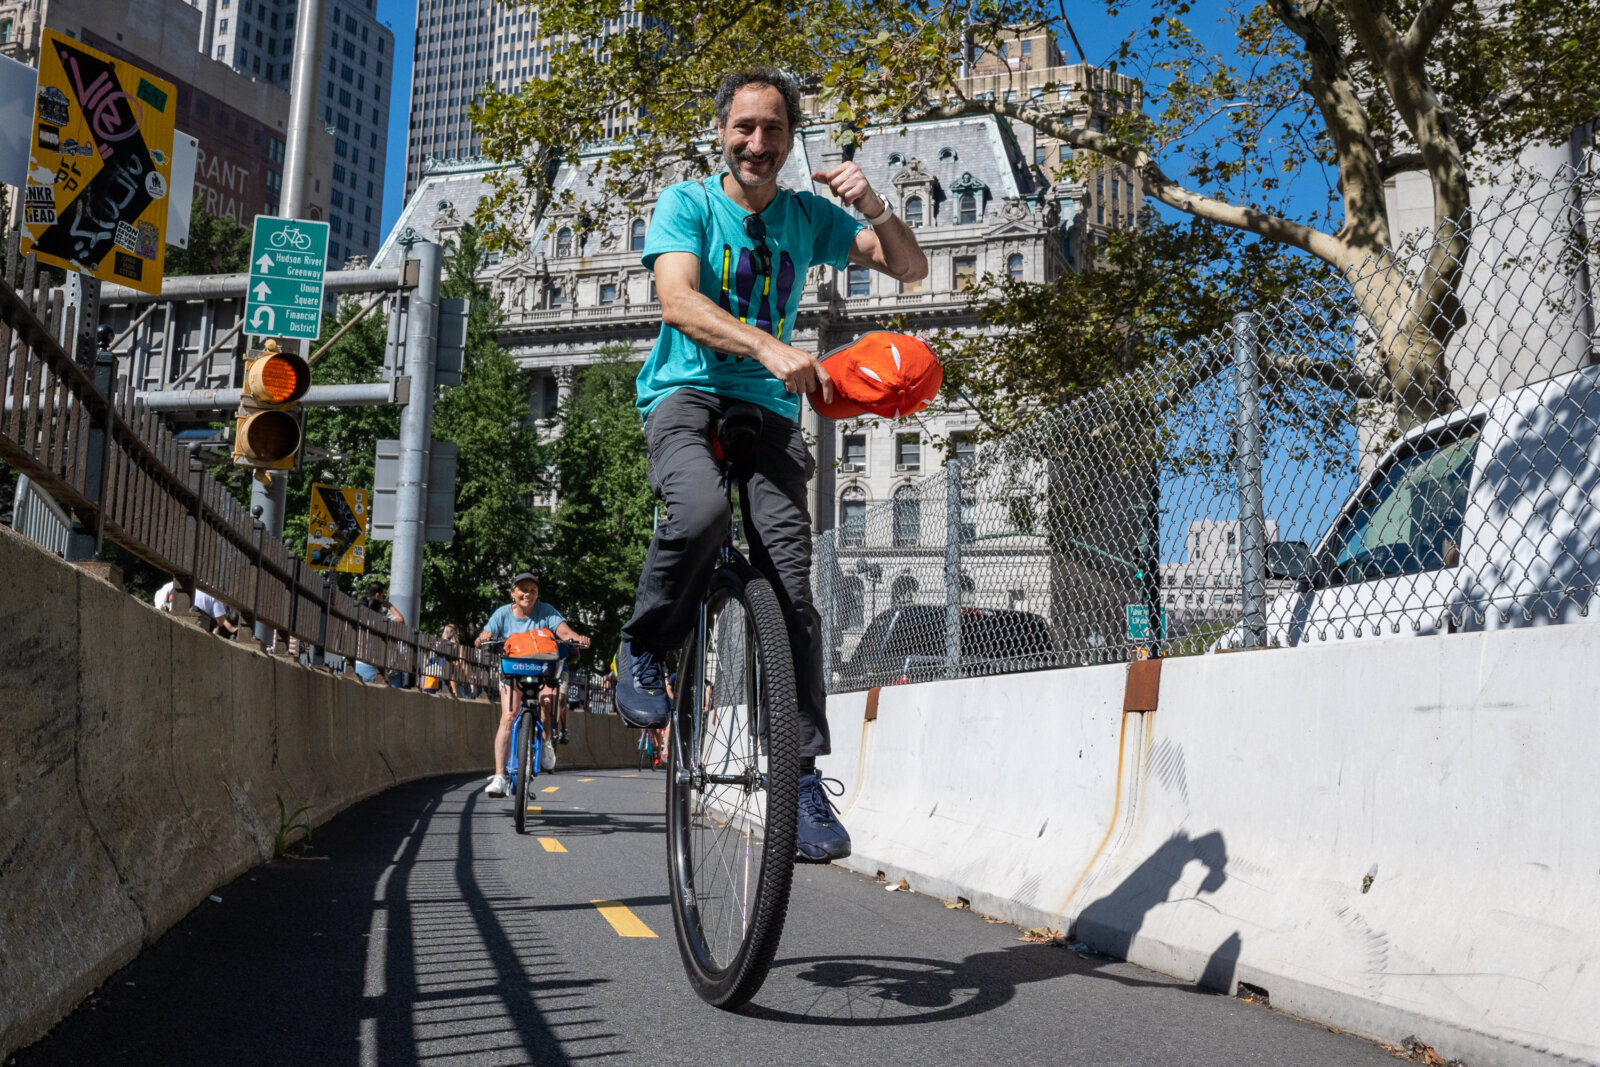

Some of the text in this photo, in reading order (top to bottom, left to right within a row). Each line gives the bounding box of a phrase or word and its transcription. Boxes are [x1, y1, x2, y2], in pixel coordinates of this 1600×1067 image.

[195, 148, 249, 194] RANT
[194, 181, 249, 229] TRIAL
[118, 221, 138, 236] ZION
[276, 252, 322, 266] Hudson River
[287, 266, 321, 279] Greenway
[300, 283, 319, 293] Union
[294, 294, 318, 306] Square
[285, 309, 317, 321] Financial
[290, 322, 316, 333] District
[525, 663, 541, 671] bike
